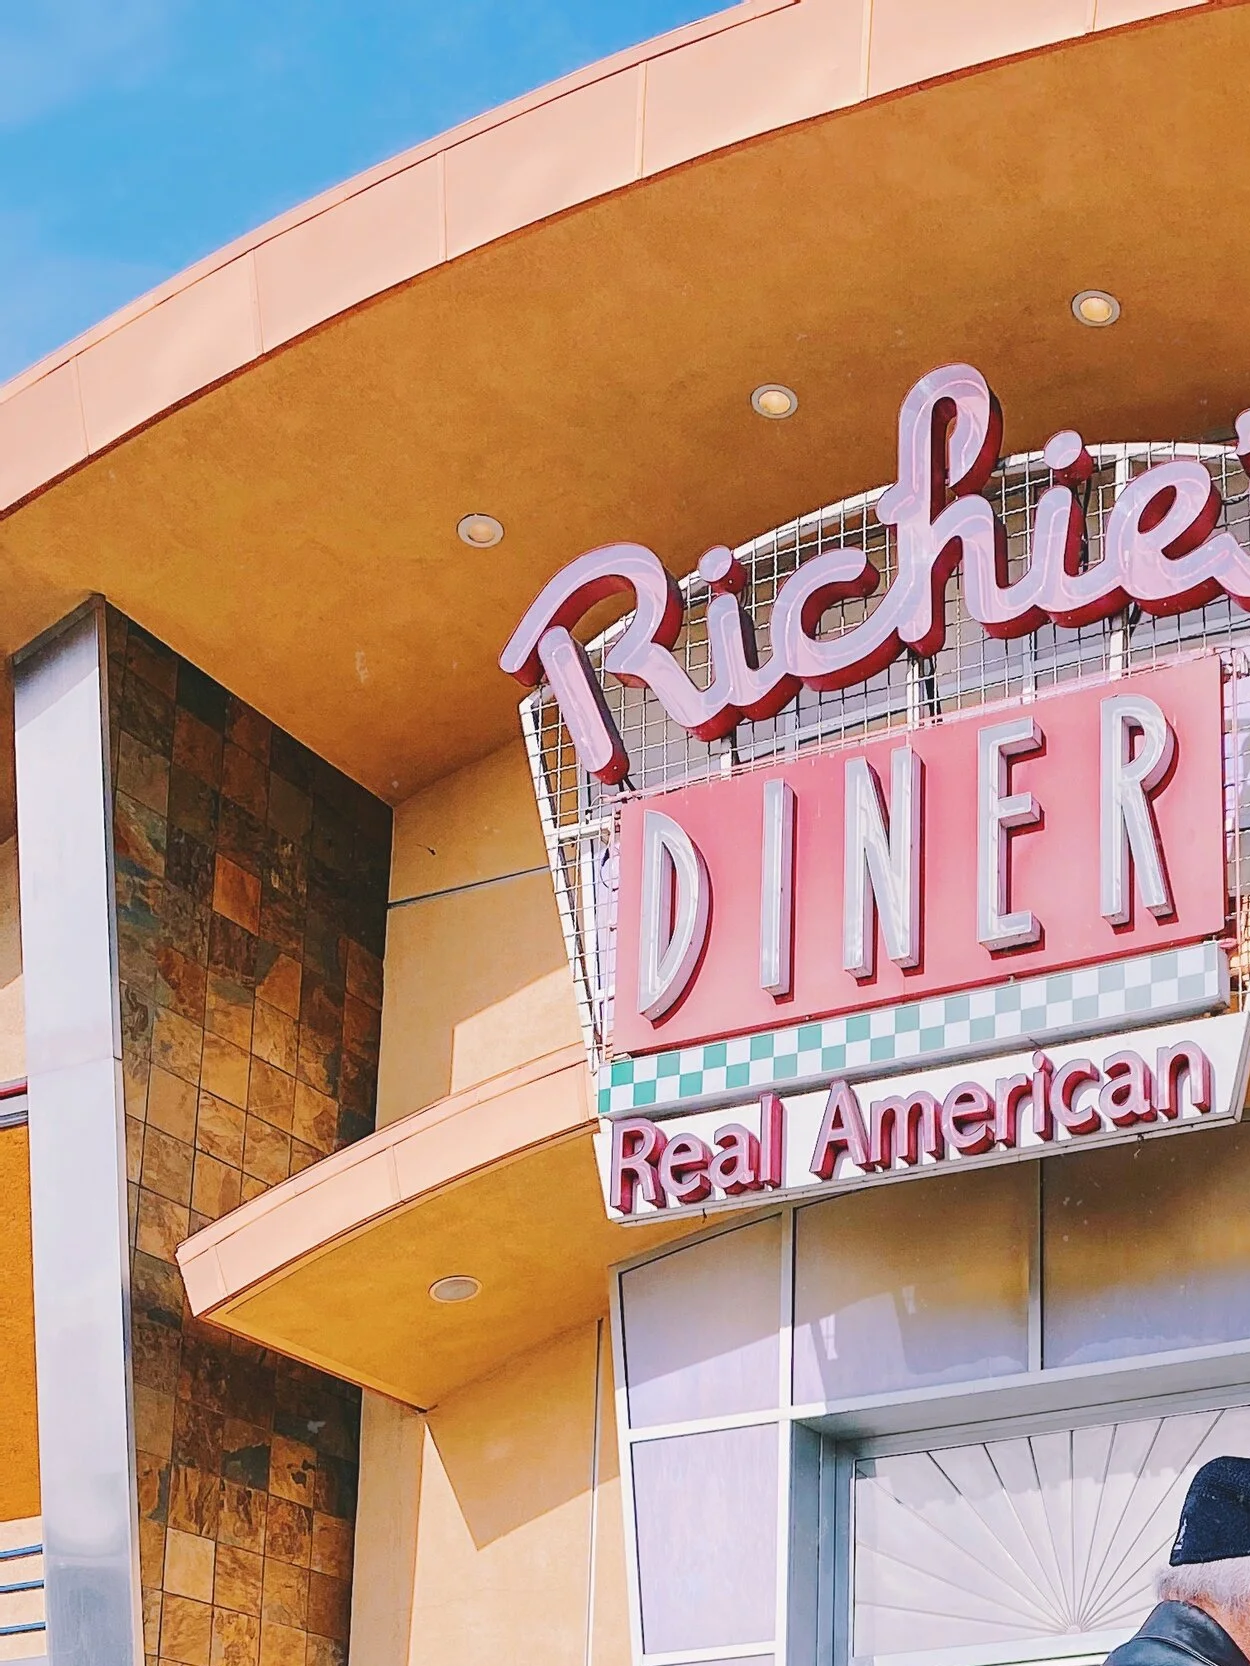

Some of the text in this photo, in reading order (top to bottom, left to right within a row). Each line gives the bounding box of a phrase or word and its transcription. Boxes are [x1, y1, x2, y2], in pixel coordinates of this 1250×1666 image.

[638, 694, 1178, 1026] DINER
[609, 1040, 1213, 1215] Real American
